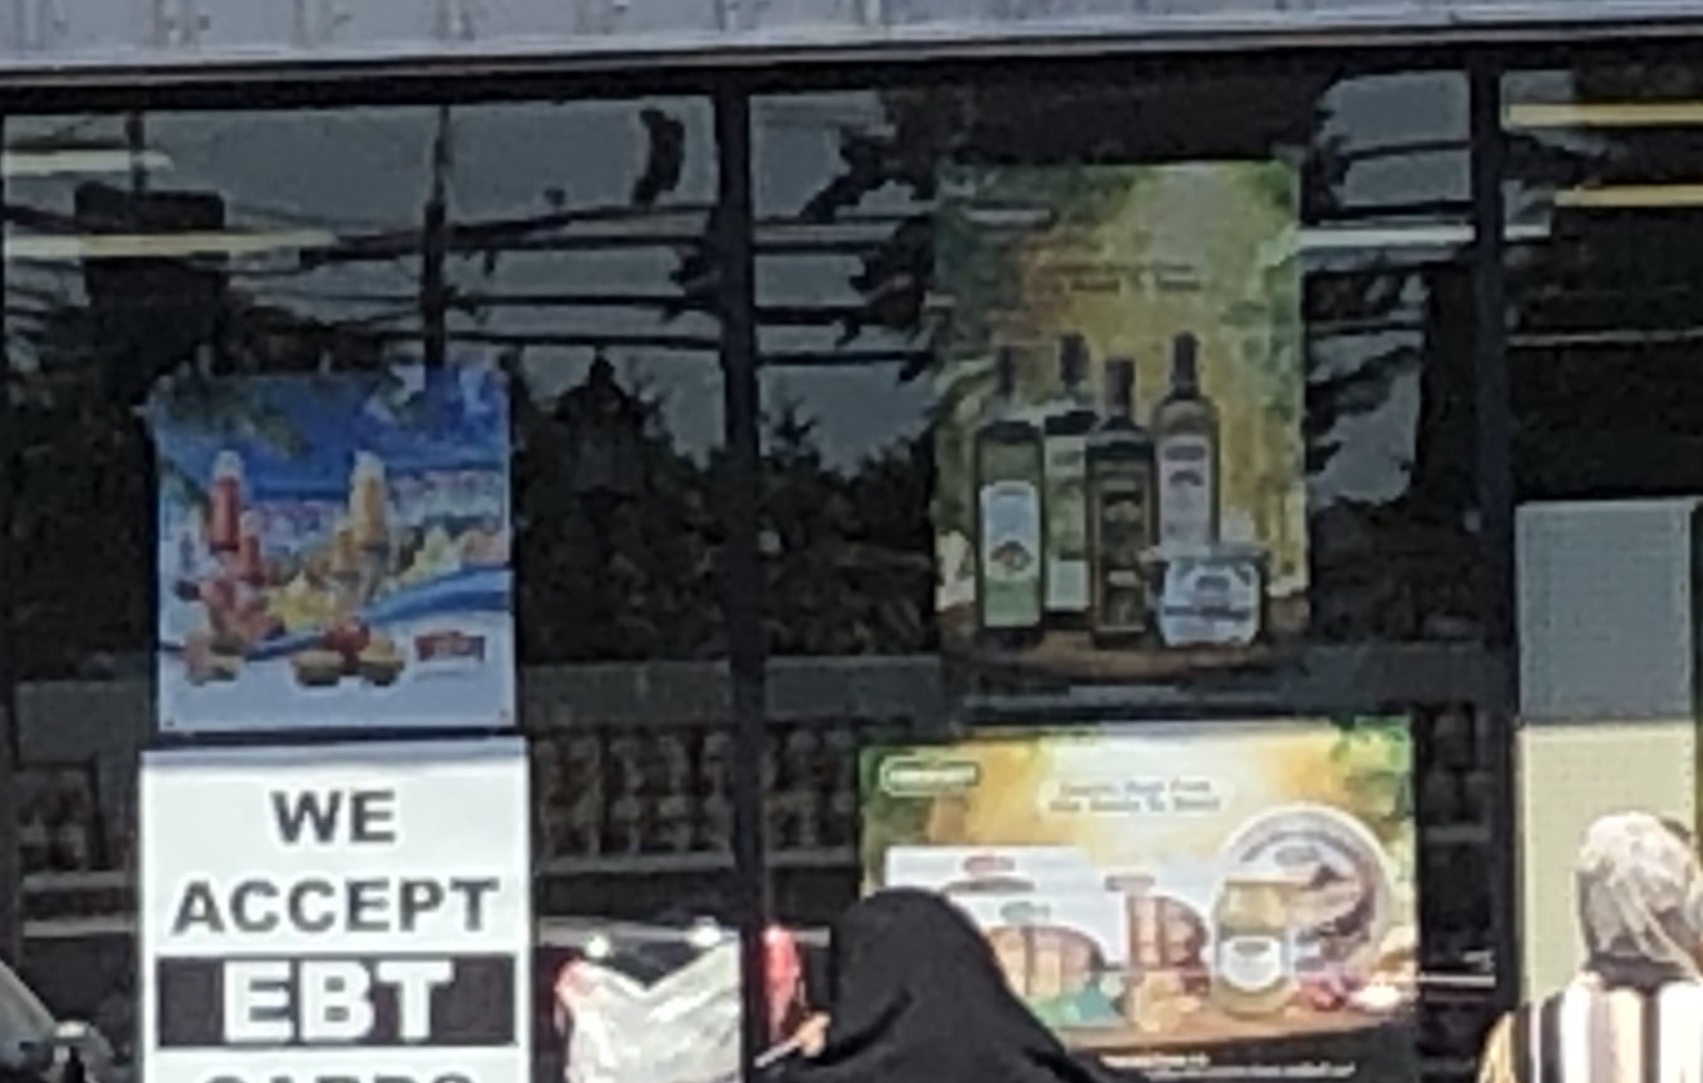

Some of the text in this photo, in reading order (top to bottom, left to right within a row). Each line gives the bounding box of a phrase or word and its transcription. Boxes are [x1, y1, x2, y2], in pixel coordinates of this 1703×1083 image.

[273, 791, 395, 843] WE
[173, 879, 498, 933] ACCEPT
[223, 959, 454, 1042] EBT
